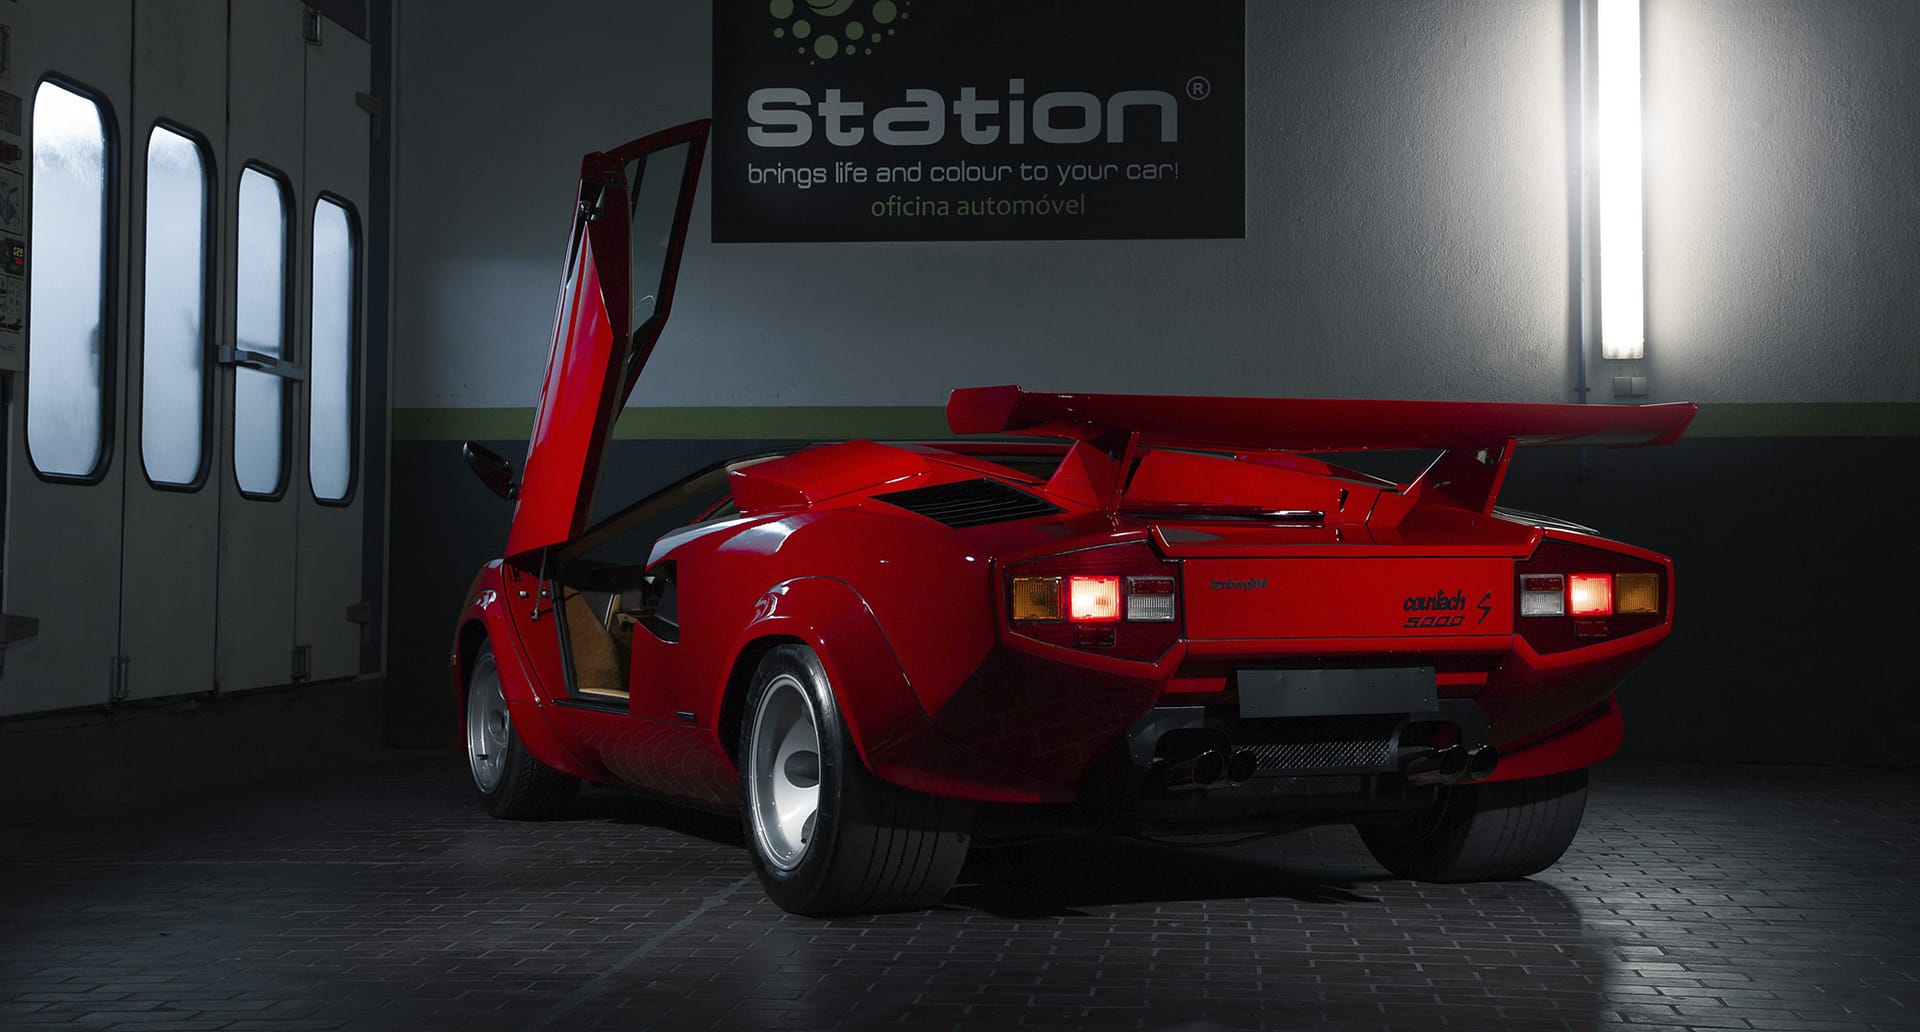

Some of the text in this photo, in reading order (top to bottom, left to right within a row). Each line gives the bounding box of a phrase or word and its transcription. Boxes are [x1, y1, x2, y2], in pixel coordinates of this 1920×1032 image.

[747, 78, 1178, 147] Station
[747, 159, 1180, 189] brings life and colour to your car!
[870, 193, 1086, 218] oficina automóvel
